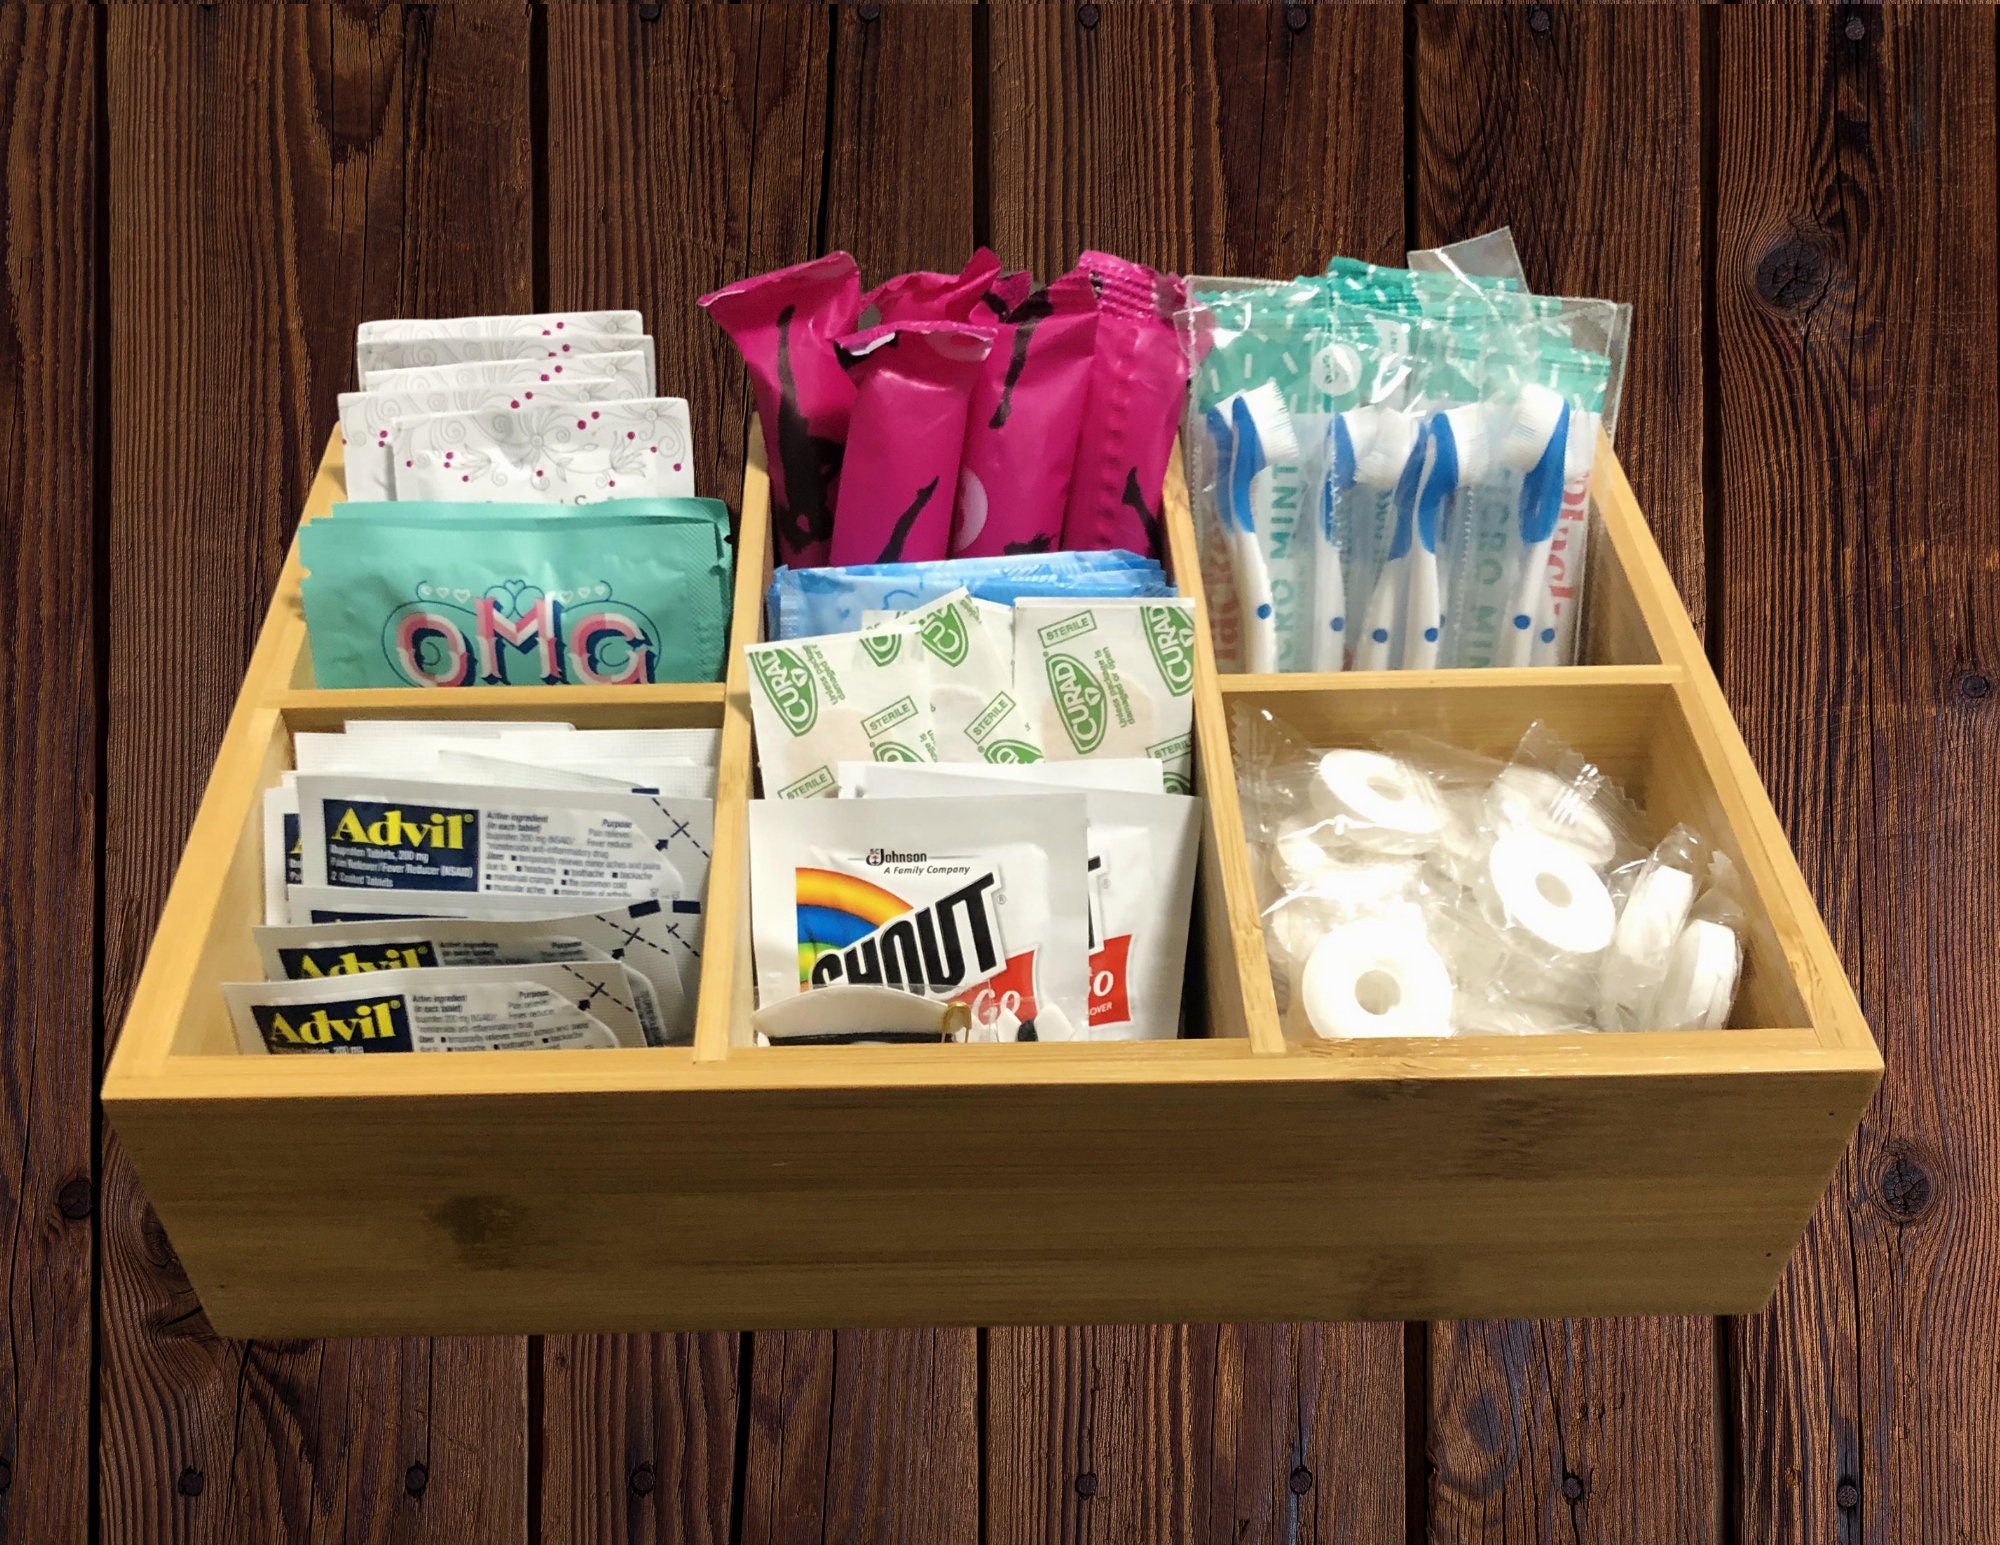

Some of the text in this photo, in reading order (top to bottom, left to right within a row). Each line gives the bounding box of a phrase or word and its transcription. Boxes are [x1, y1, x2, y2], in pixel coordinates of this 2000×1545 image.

[1269, 463, 1298, 560] MINT
[397, 592, 657, 687] OMG
[1046, 617, 1090, 642] STERILE
[1150, 606, 1192, 682] CURAD
[757, 649, 811, 723] CURAD
[1055, 662, 1098, 741] CURAD
[869, 703, 911, 731] STERILE
[972, 699, 1009, 738] STERILE
[786, 772, 828, 799] STERILE
[331, 807, 464, 849] Advil
[884, 865, 970, 876] A Family Company
[269, 1002, 397, 1045] Advil
